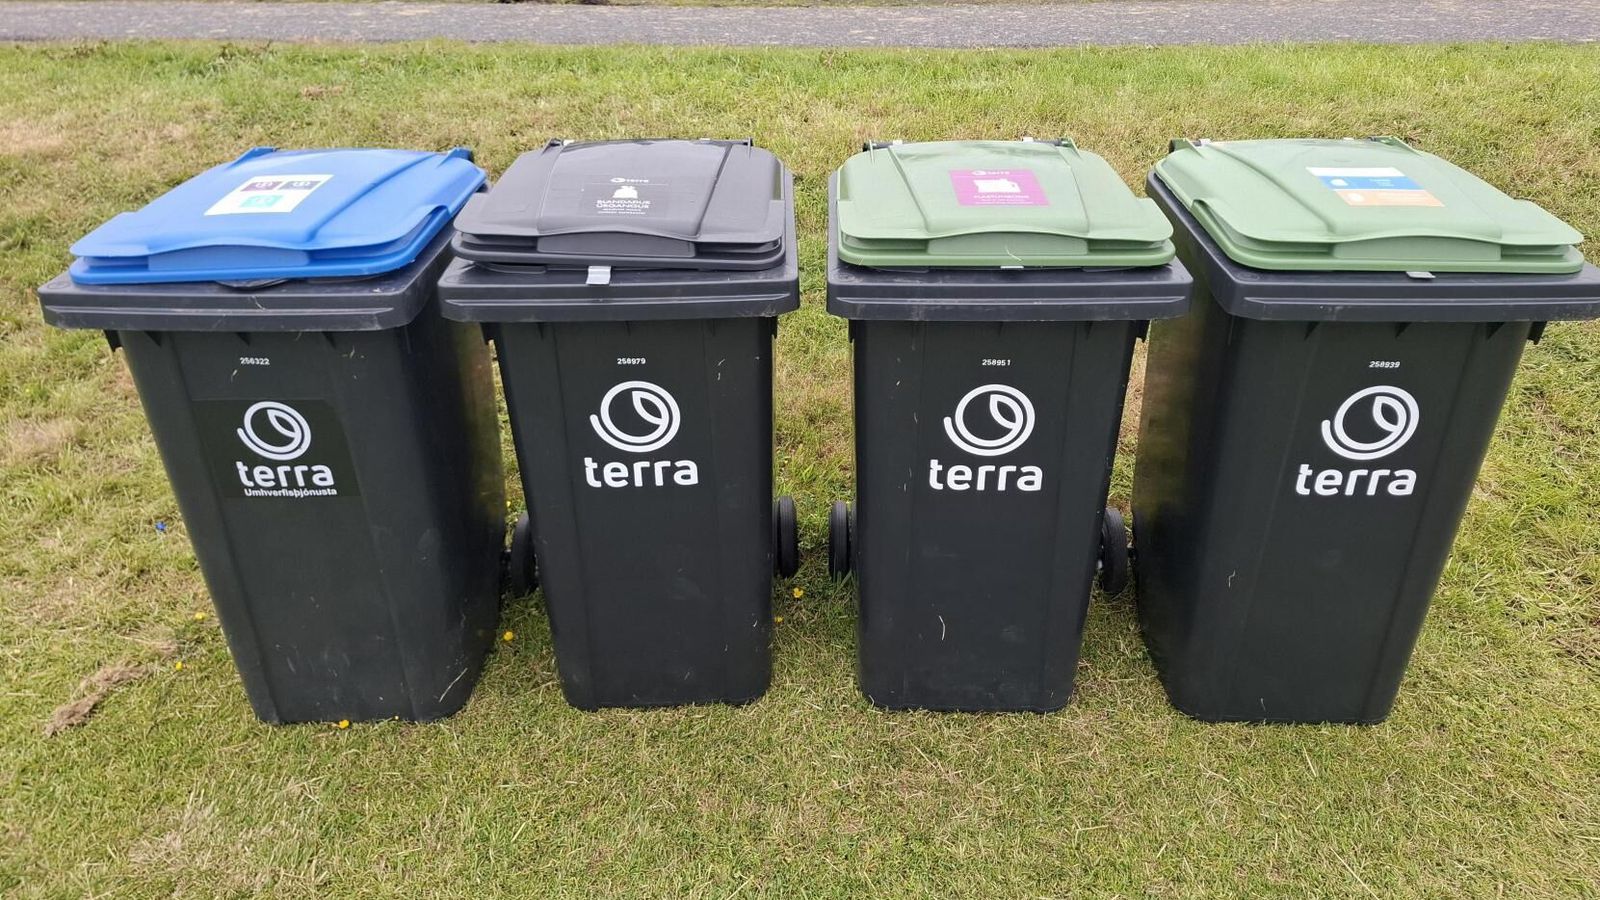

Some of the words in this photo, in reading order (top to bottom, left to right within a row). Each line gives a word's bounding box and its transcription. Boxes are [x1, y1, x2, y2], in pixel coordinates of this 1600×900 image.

[616, 357, 646, 366] 258979
[981, 358, 1011, 367] 258951
[1368, 360, 1401, 369] 258939
[235, 461, 335, 488] terra
[584, 457, 699, 488] terra
[929, 458, 1043, 492] terra
[1295, 464, 1417, 497] terra
[243, 487, 338, 499] Umhverfisþjónusta
